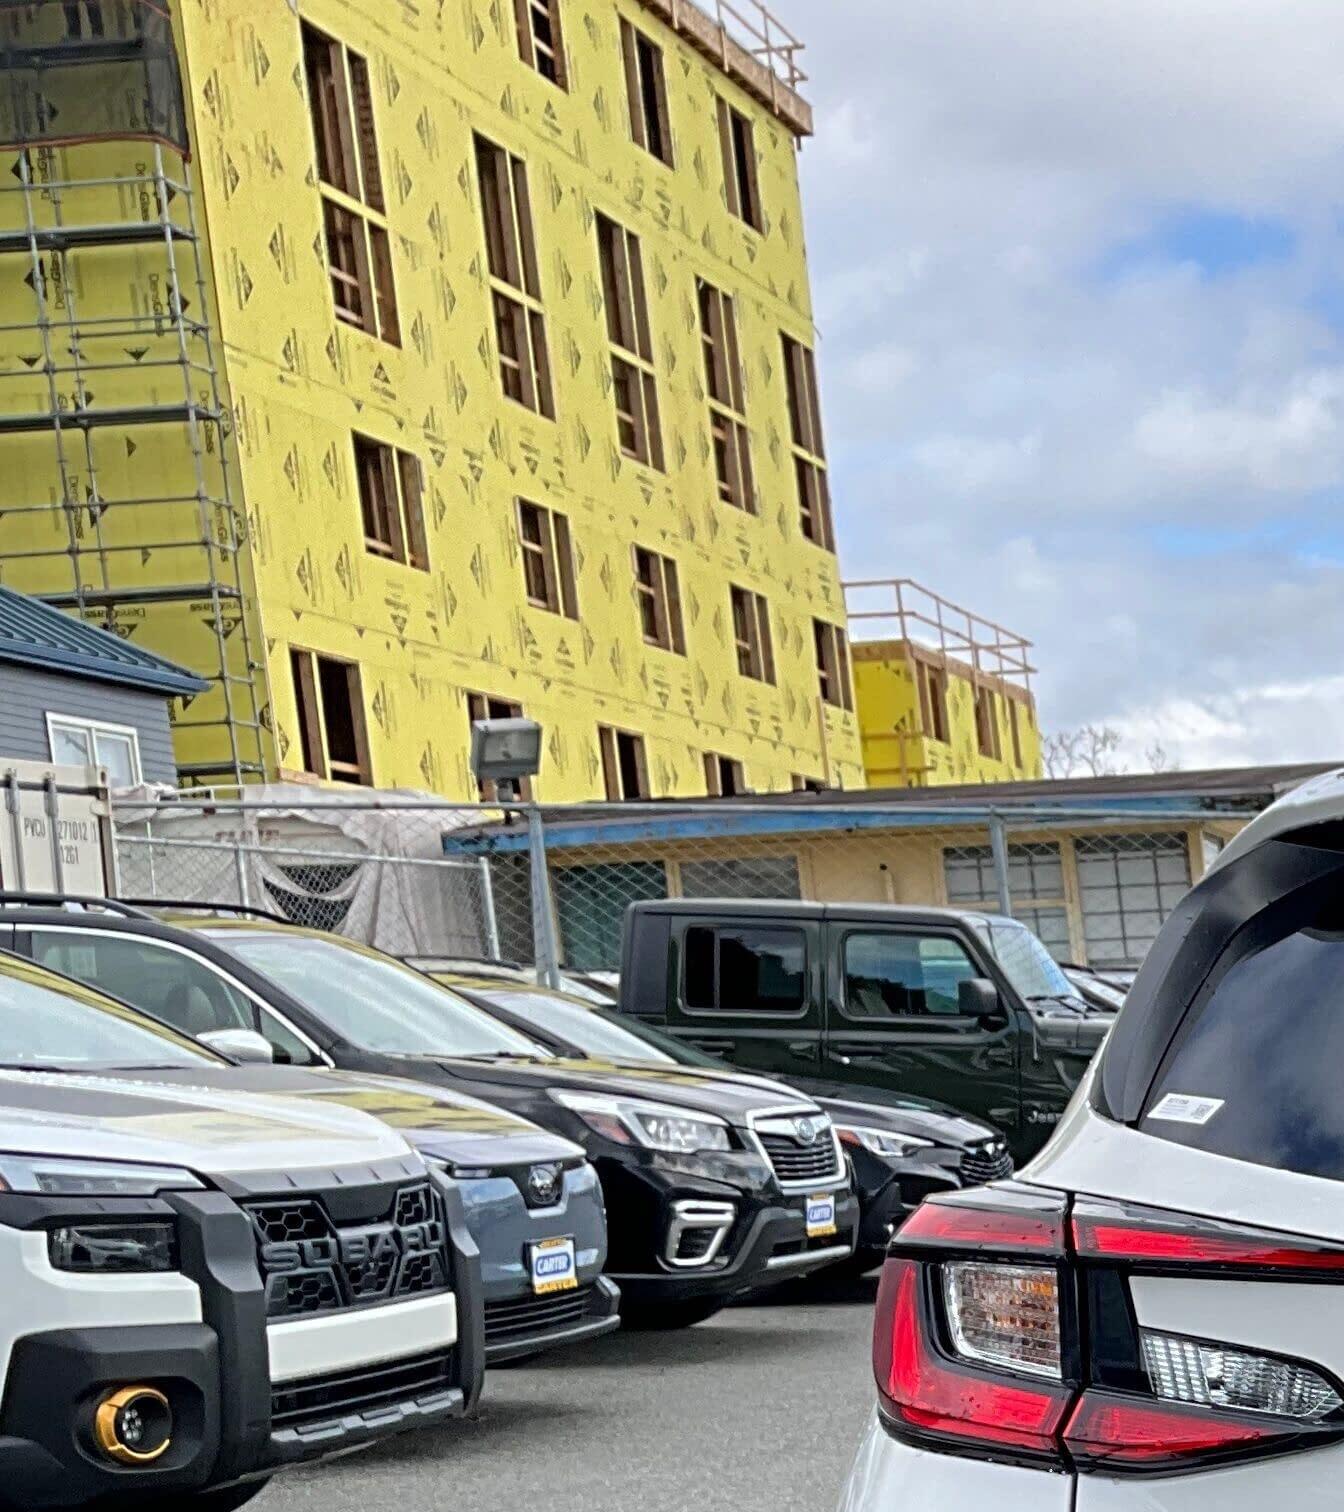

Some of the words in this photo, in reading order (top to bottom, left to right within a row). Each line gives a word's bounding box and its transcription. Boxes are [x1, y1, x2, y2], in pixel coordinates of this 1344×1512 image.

[57, 820, 88, 841] 271012
[262, 1222, 445, 1271] SUBARU
[537, 1254, 569, 1274] CARTER
